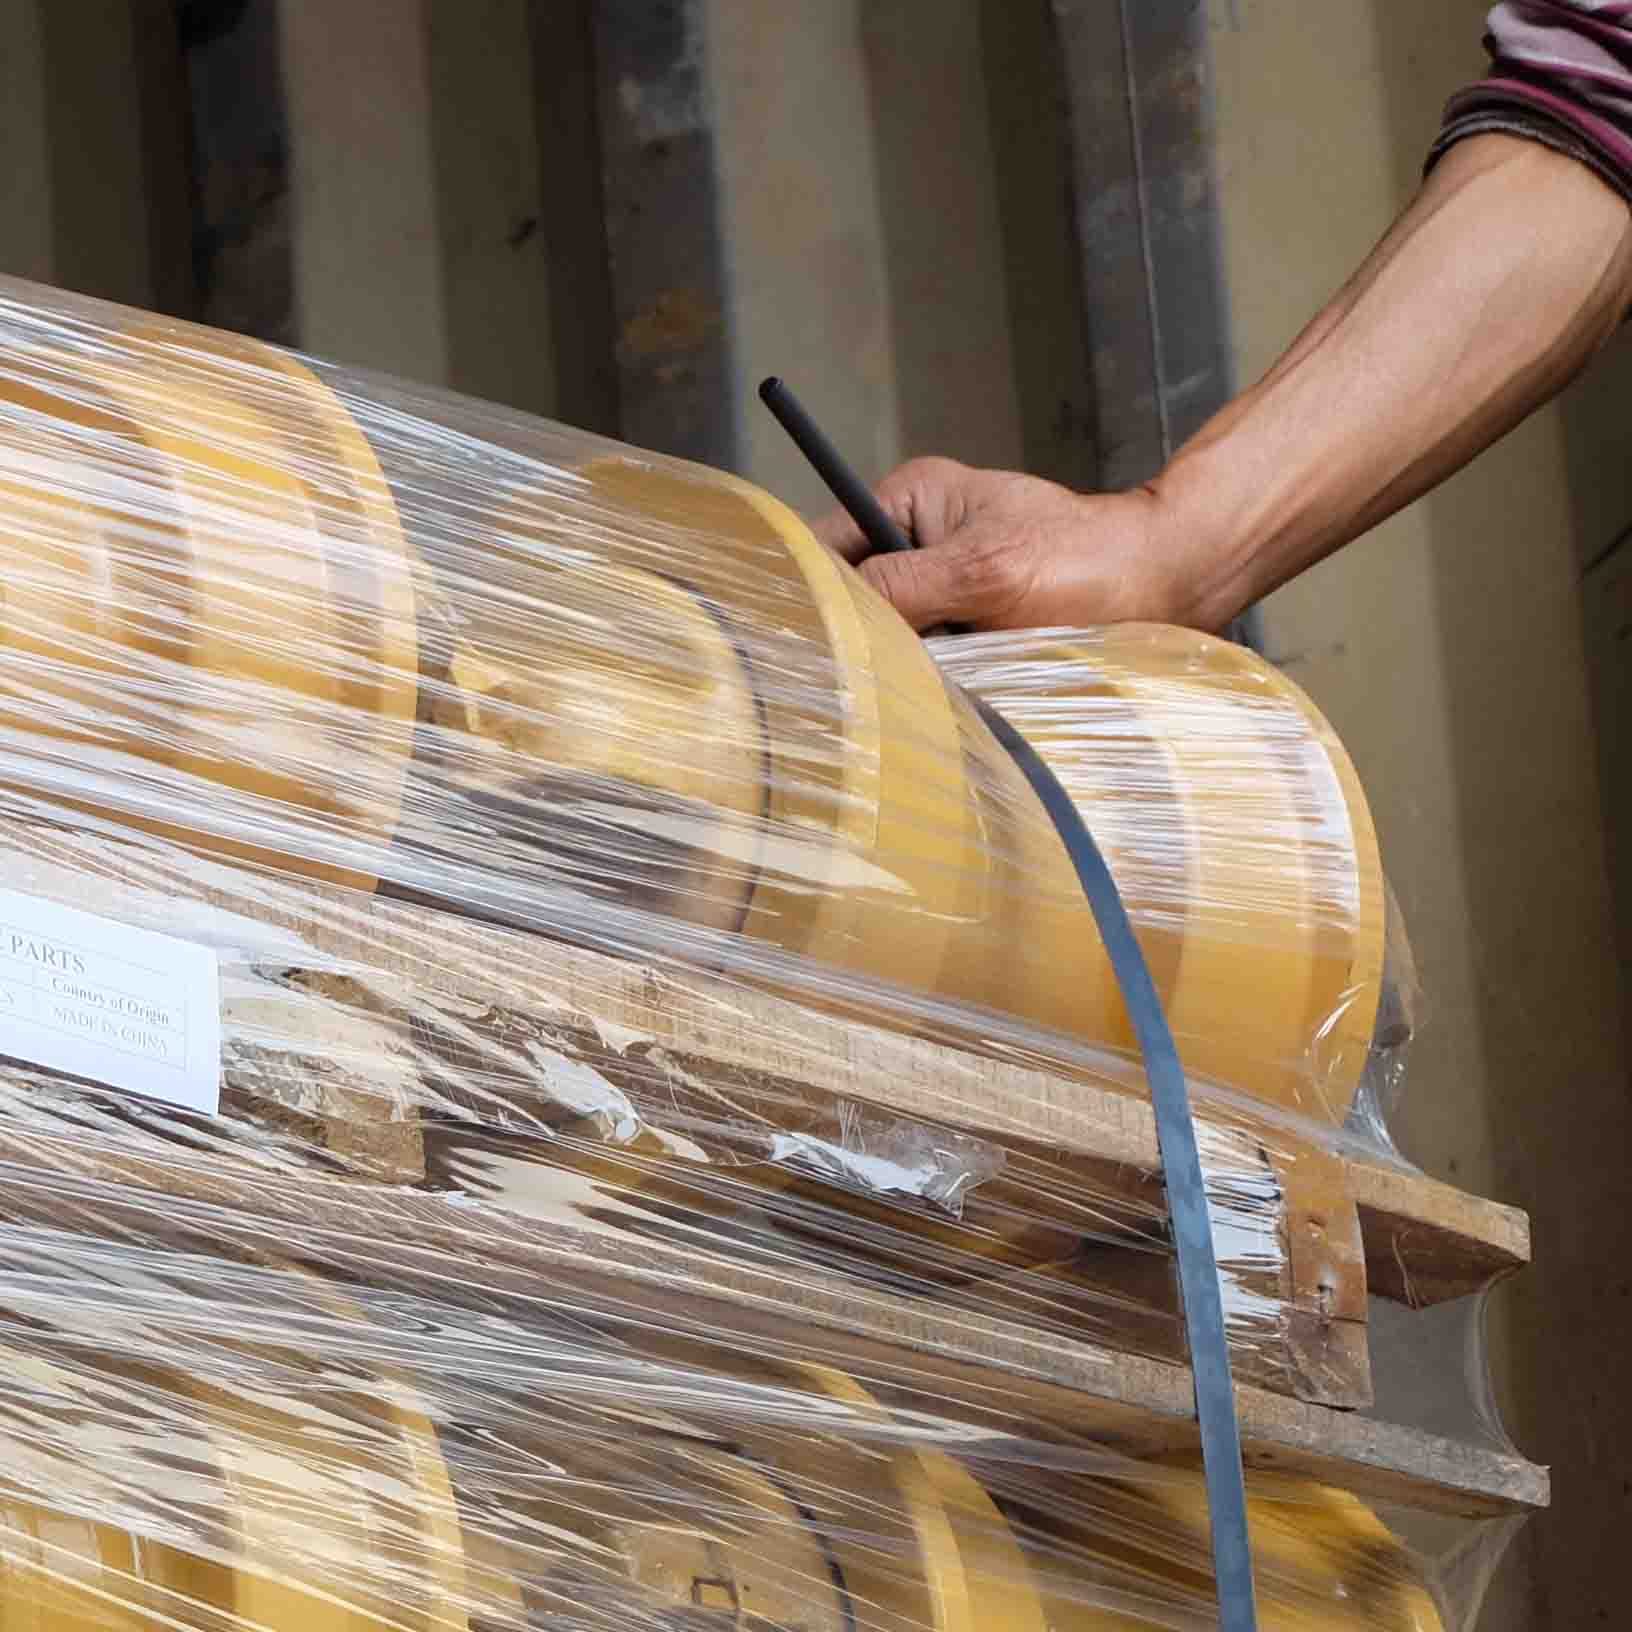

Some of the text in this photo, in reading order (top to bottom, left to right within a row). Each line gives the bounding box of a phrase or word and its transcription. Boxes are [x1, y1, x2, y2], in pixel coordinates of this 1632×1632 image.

[11, 934, 87, 975] PARTS
[51, 976, 170, 1028] Country of Origin
